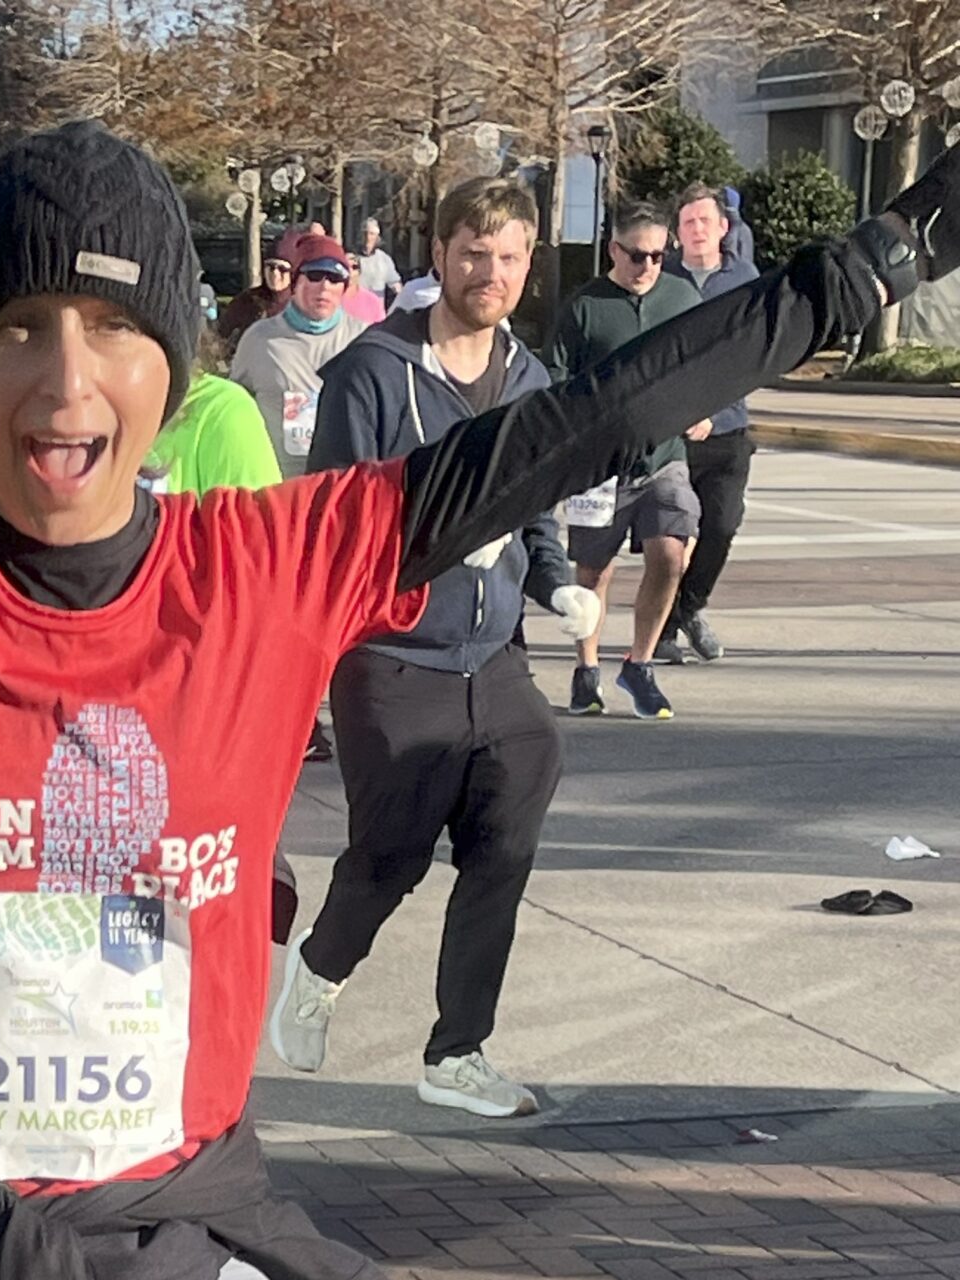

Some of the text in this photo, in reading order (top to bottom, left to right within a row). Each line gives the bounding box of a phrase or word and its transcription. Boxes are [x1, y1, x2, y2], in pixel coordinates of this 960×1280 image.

[43, 772, 84, 784] TEAM
[112, 758, 130, 826] TEAM
[141, 759, 156, 798] 2019
[91, 840, 152, 853] PLACE
[158, 824, 237, 873] BO'S
[131, 856, 239, 910] PLACE
[108, 910, 160, 927] LEGACY
[16, 1106, 157, 1132] MARGARET
